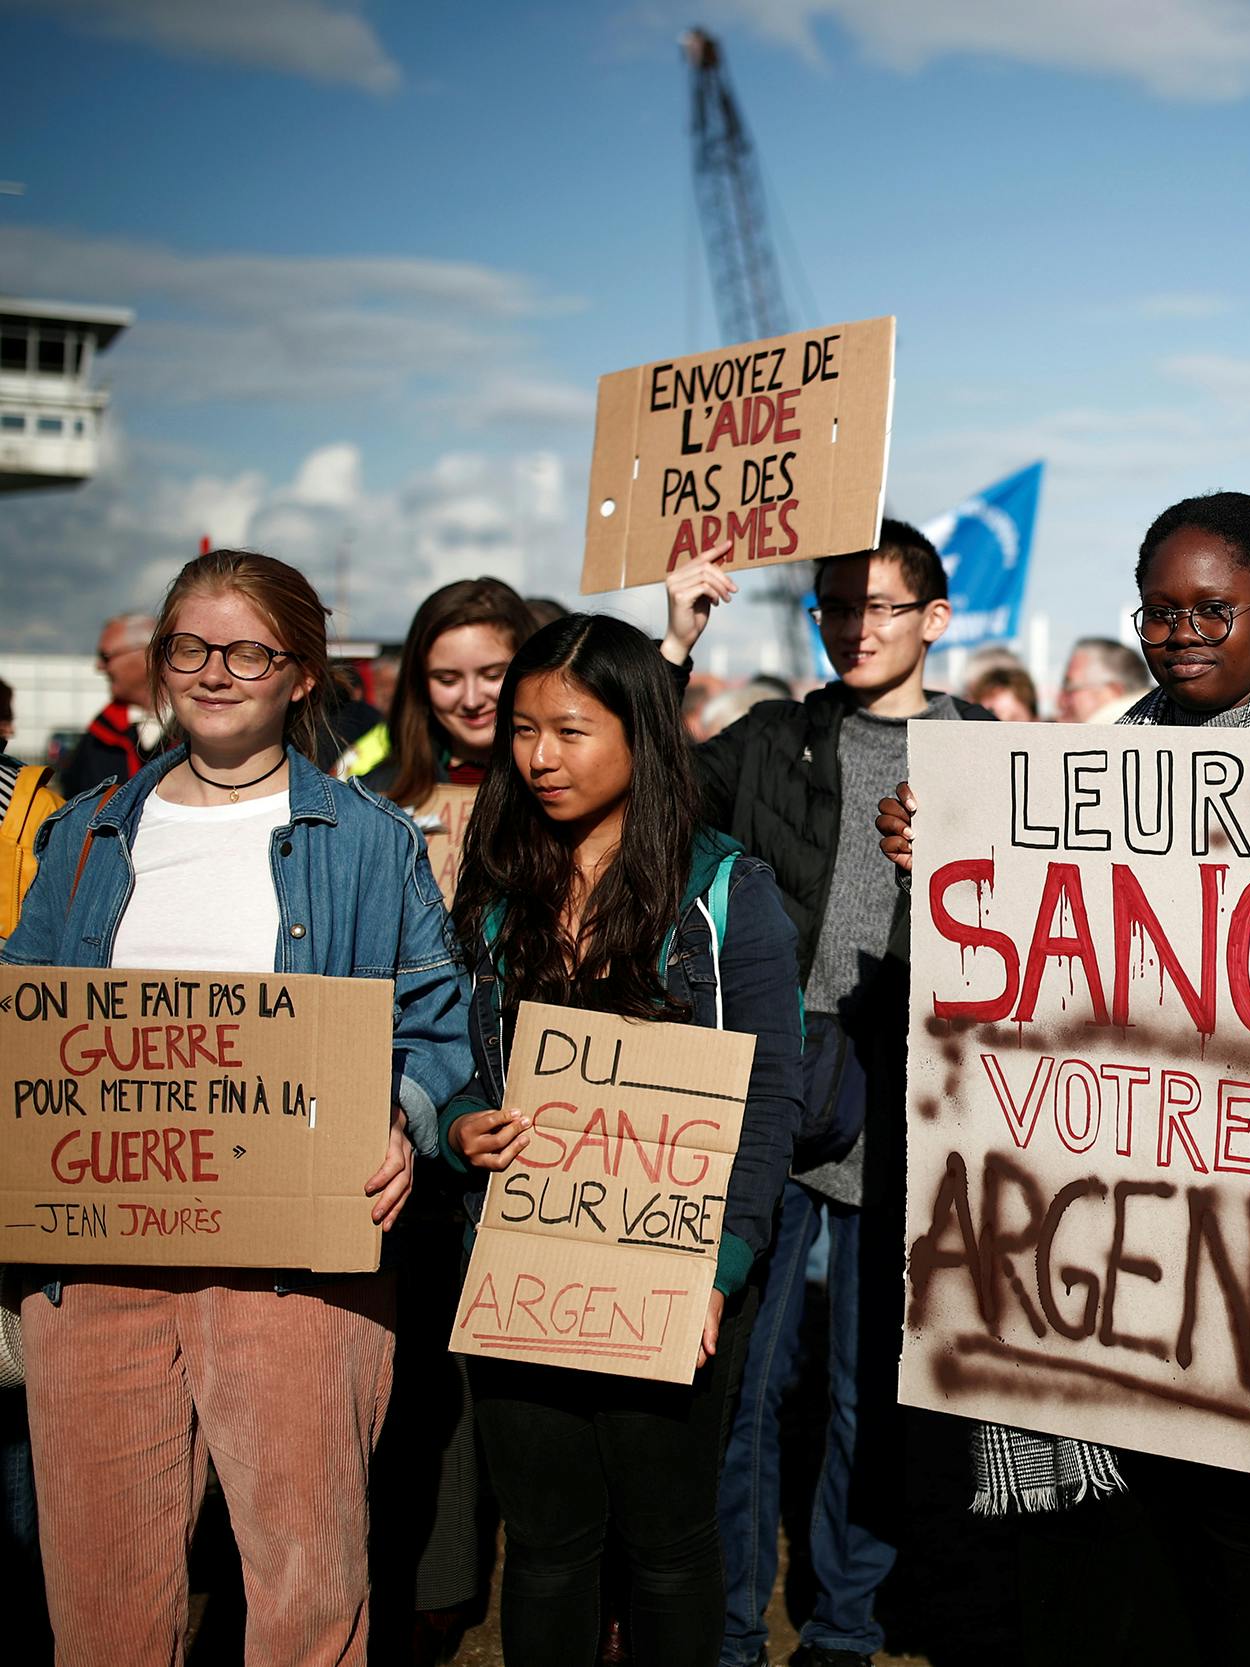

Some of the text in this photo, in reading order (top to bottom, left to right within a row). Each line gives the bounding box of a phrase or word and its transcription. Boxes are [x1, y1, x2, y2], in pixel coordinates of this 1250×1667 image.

[650, 335, 841, 412] ENVOYEZ DE
[681, 388, 802, 456] L'AIDE
[661, 452, 796, 517] PAS DES
[666, 499, 800, 573] ARMES
[87, 981, 128, 1020] NE
[141, 977, 200, 1019] FAIT
[208, 982, 246, 1018] PAS
[258, 984, 296, 1019] LA
[59, 1023, 243, 1077] GUERRE
[534, 1029, 623, 1086] DU
[14, 1074, 307, 1119] POUR METTRE FIN À LA
[50, 1127, 219, 1185] GUERRE
[514, 1101, 721, 1188] SANG
[118, 1196, 223, 1238] JAURÈS
[501, 1173, 607, 1234] SUR
[459, 1271, 689, 1346] ARGENT
